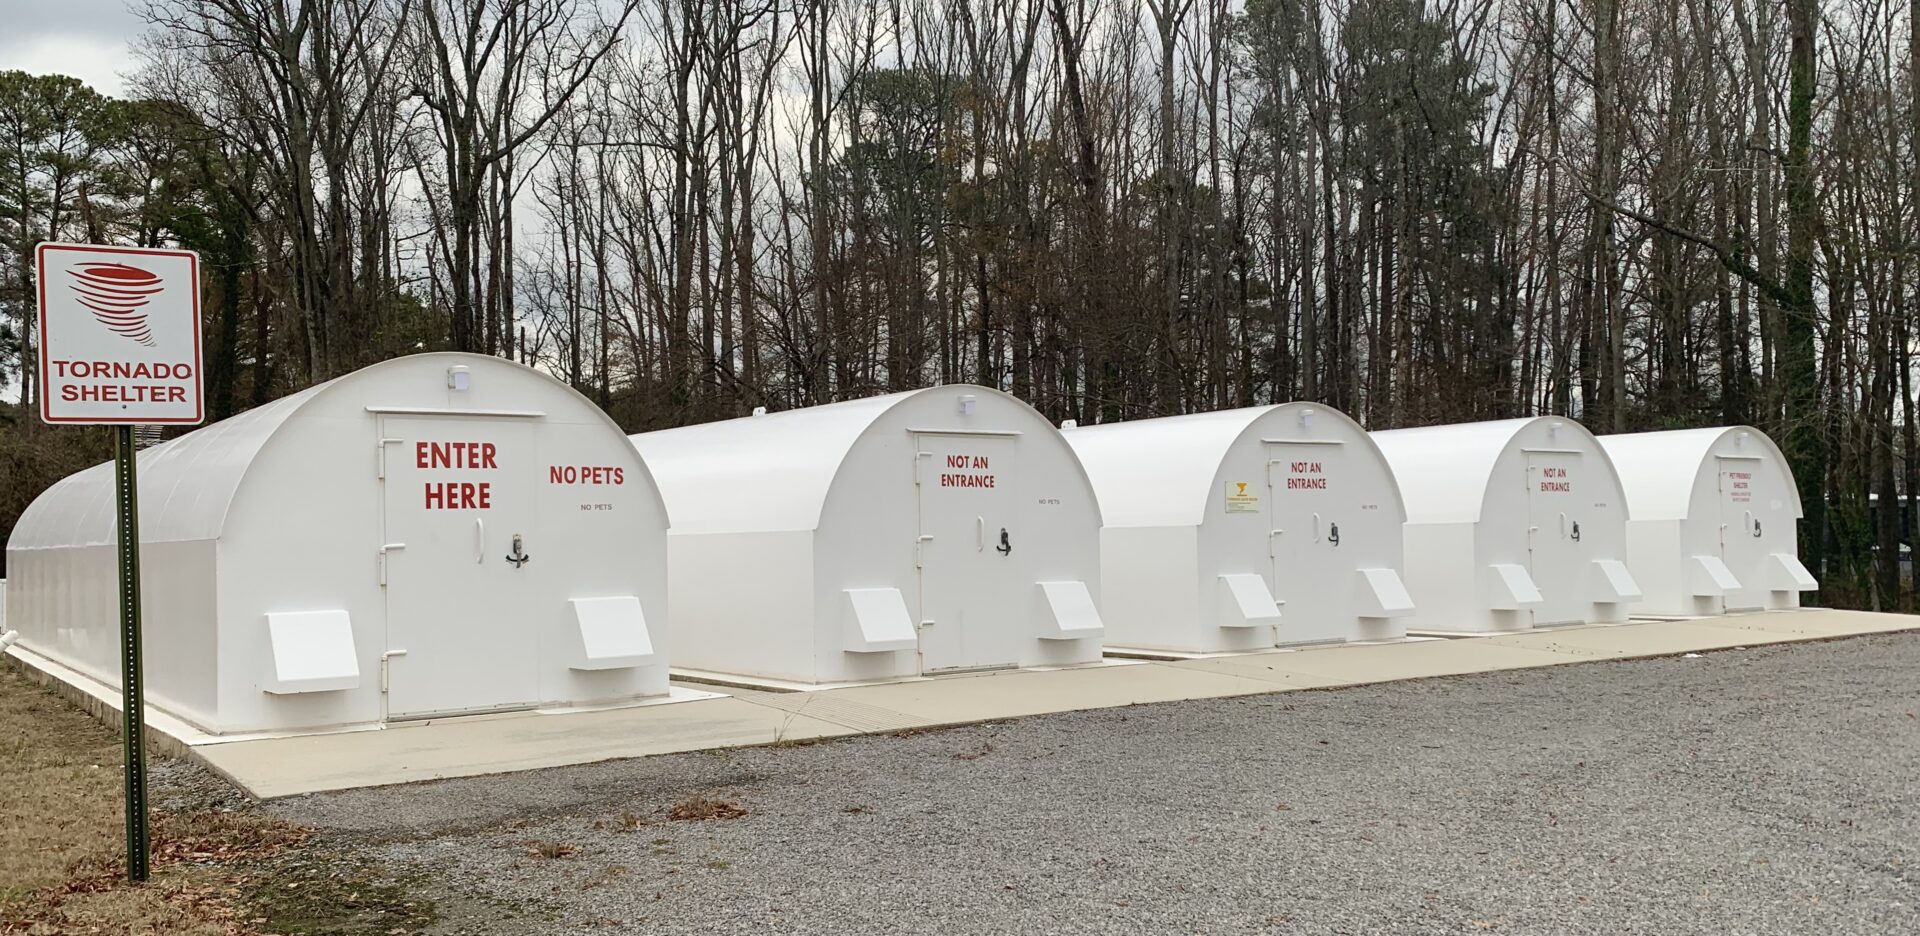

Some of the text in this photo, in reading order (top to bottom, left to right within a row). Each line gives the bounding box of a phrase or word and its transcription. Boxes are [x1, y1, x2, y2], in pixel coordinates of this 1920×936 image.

[52, 361, 192, 379] TORNADO
[61, 385, 187, 402] SHELTER
[416, 442, 497, 469] ENTER
[947, 455, 988, 469] NOT AN
[1291, 462, 1321, 473] NOT AN
[1543, 468, 1566, 478] NOT AN
[550, 466, 624, 485] NO PETS
[941, 474, 994, 488] ENTRANCE
[1287, 478, 1326, 489] ENTRANCE
[1541, 482, 1570, 492] ENTRANCE
[425, 483, 491, 509] HERE
